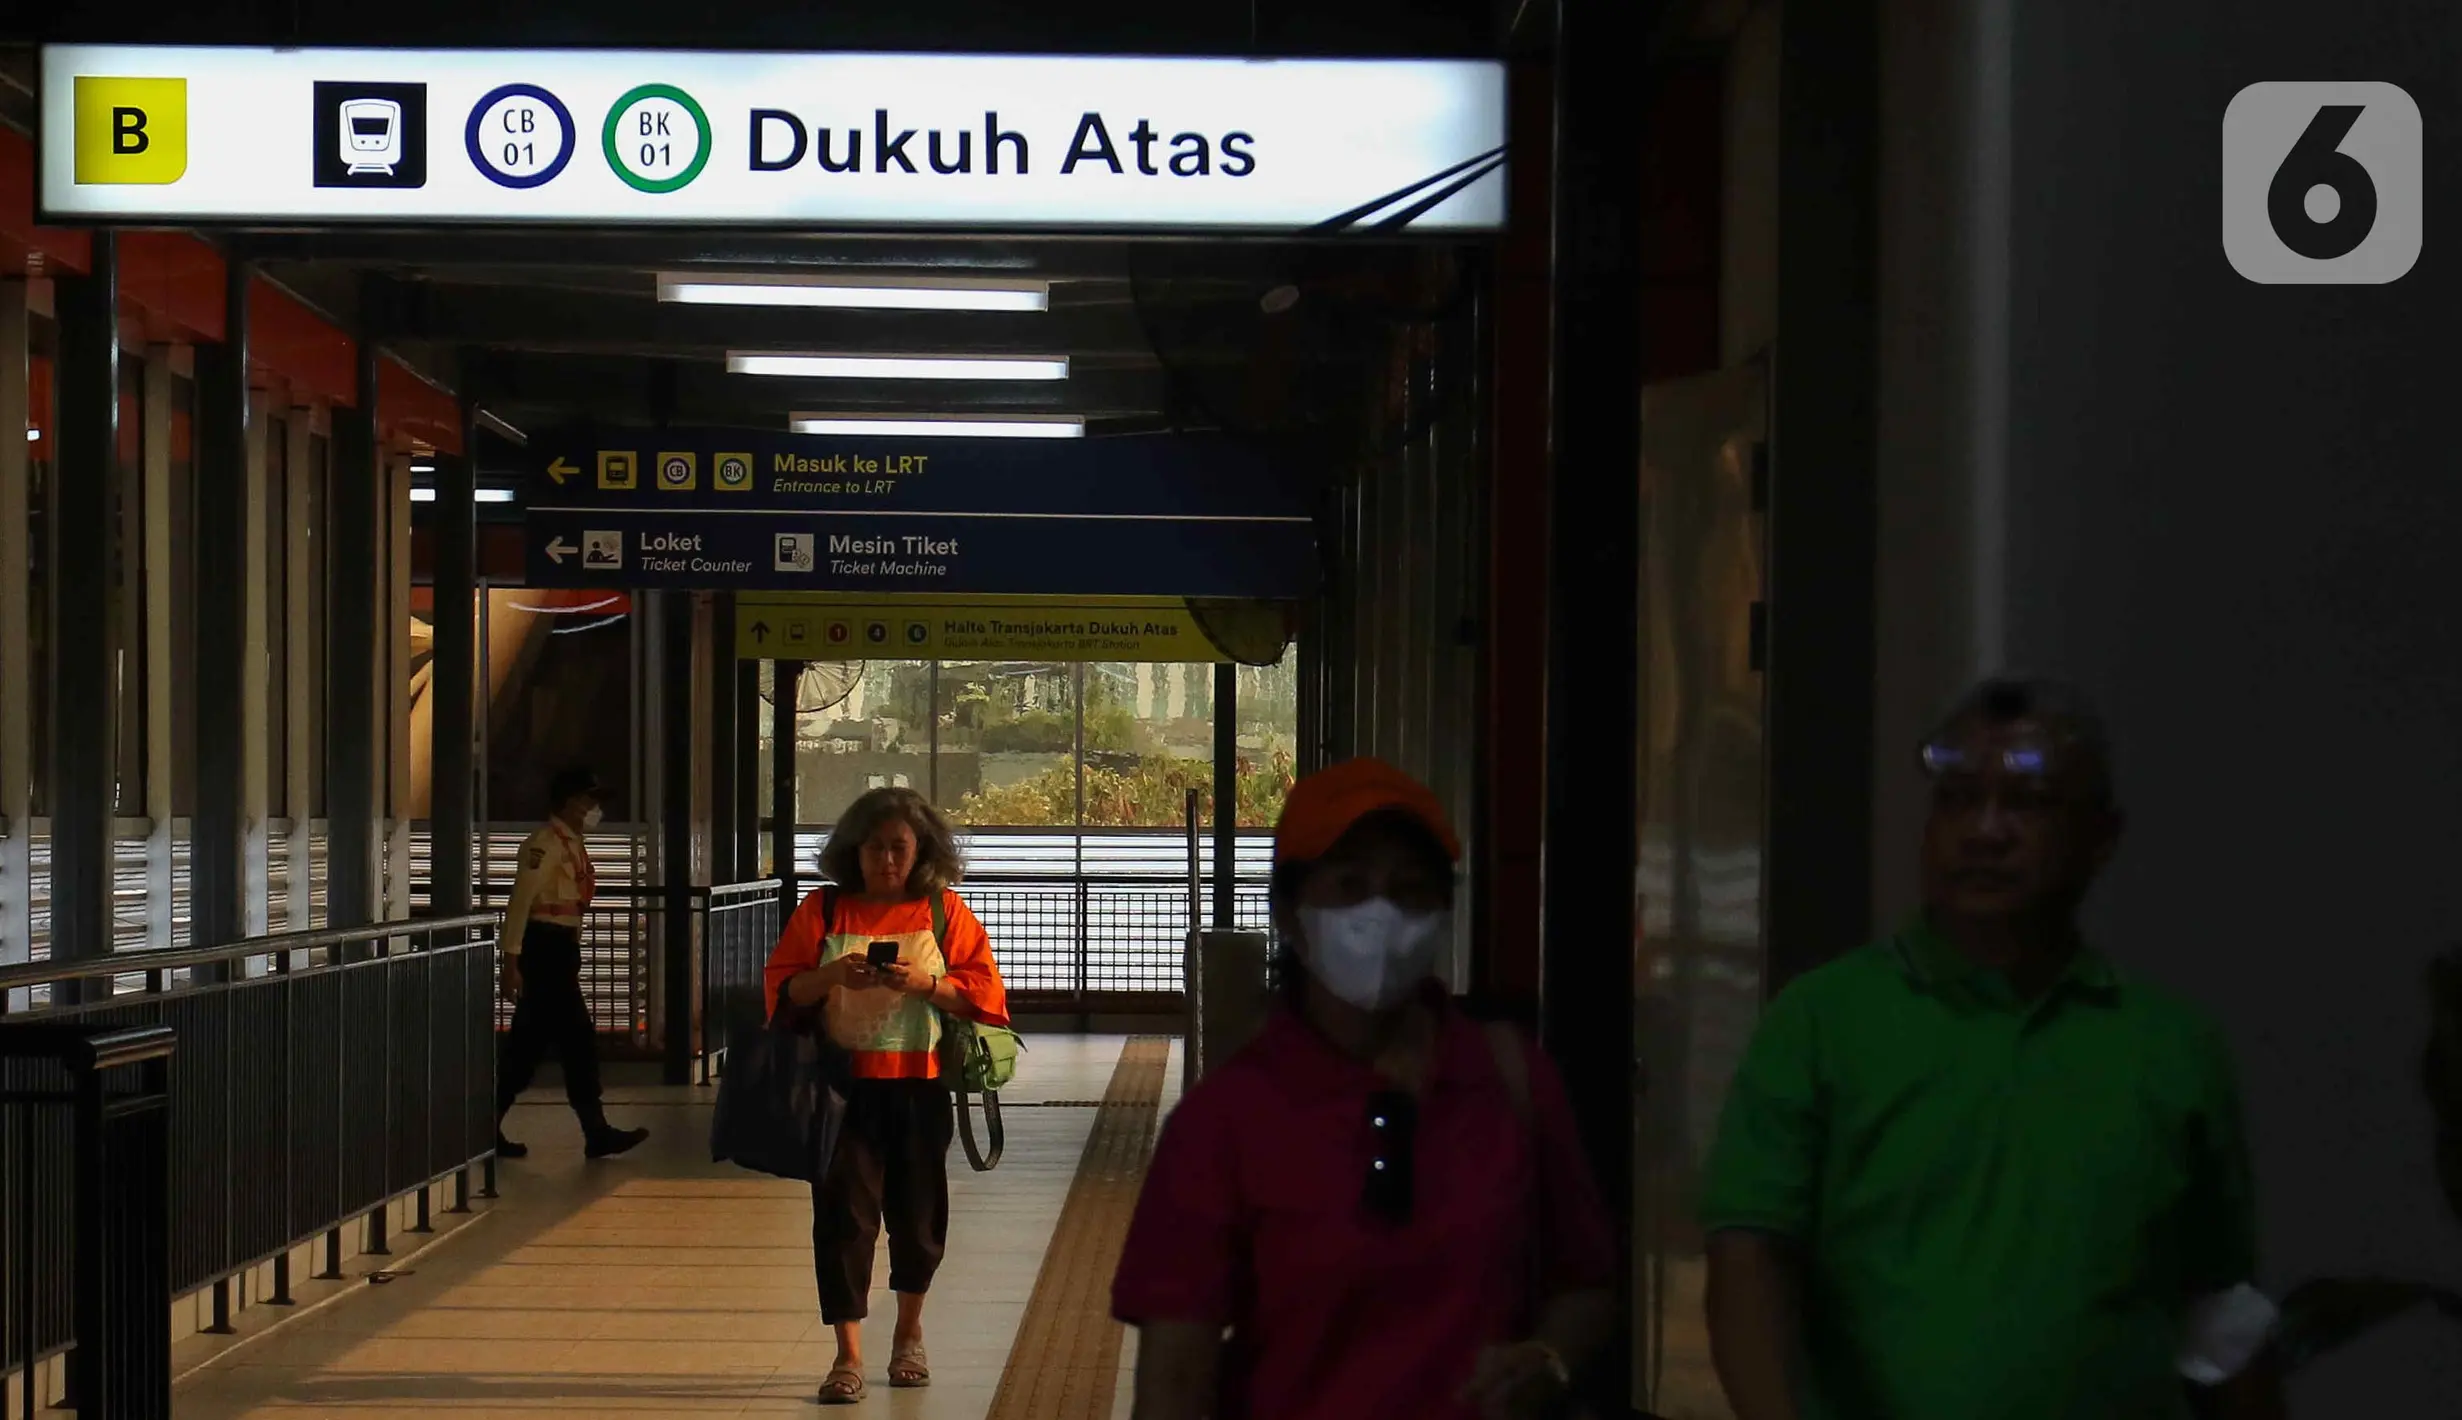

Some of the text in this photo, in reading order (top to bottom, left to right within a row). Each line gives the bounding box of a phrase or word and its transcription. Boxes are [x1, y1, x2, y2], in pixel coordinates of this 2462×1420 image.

[112, 106, 150, 155] B
[503, 109, 535, 134] CB
[639, 112, 671, 137] BK
[748, 107, 1257, 178] Dukuh Atas
[503, 142, 535, 167] 01
[640, 144, 671, 168] 01
[669, 465, 683, 477] CB
[725, 465, 741, 478] BK
[774, 453, 928, 474] Masuk ke LRT
[773, 479, 895, 494] Entrance to LRT
[640, 532, 702, 551] Loket
[829, 535, 959, 556] Mesin Tiket
[641, 557, 751, 573] Ticket Counter
[830, 560, 946, 576] Ticket Machine
[944, 620, 1178, 637] Halte Transjakarta Dukuh Atas
